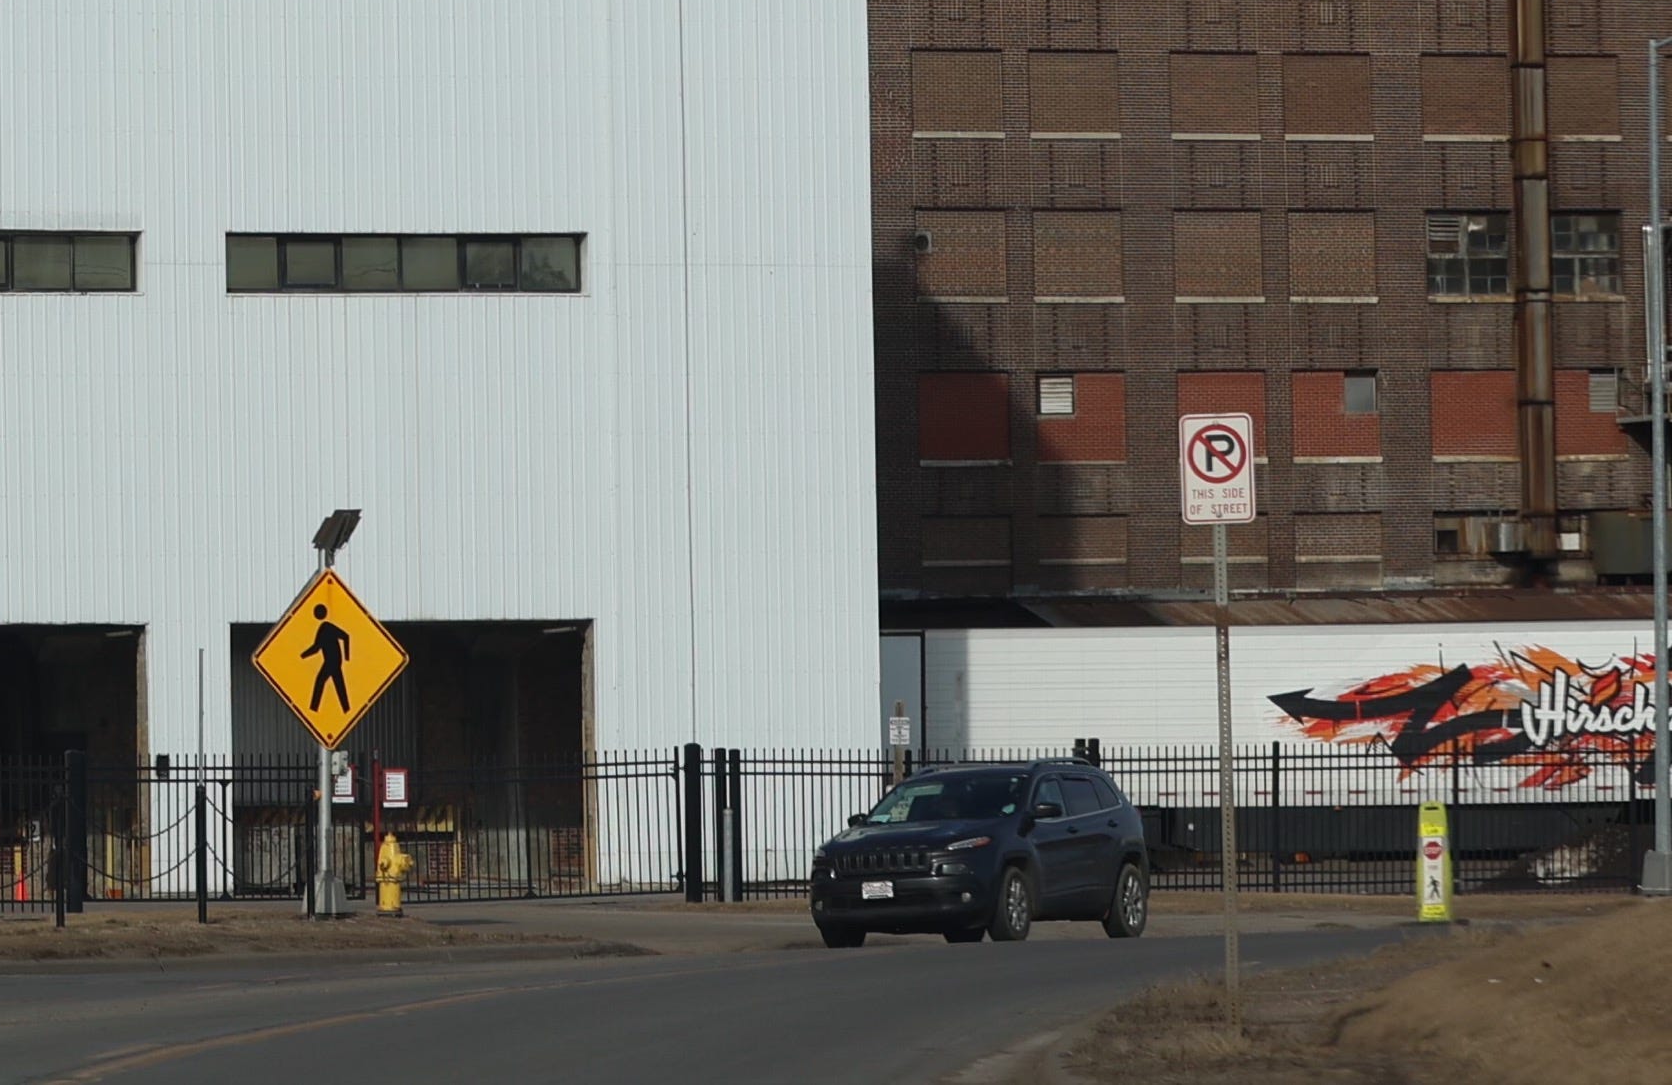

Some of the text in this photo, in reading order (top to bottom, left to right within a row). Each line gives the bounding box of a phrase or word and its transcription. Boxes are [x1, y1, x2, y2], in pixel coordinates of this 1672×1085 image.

[1192, 487, 1245, 500] THIS SIDE
[1190, 503, 1248, 515] OF STREET
